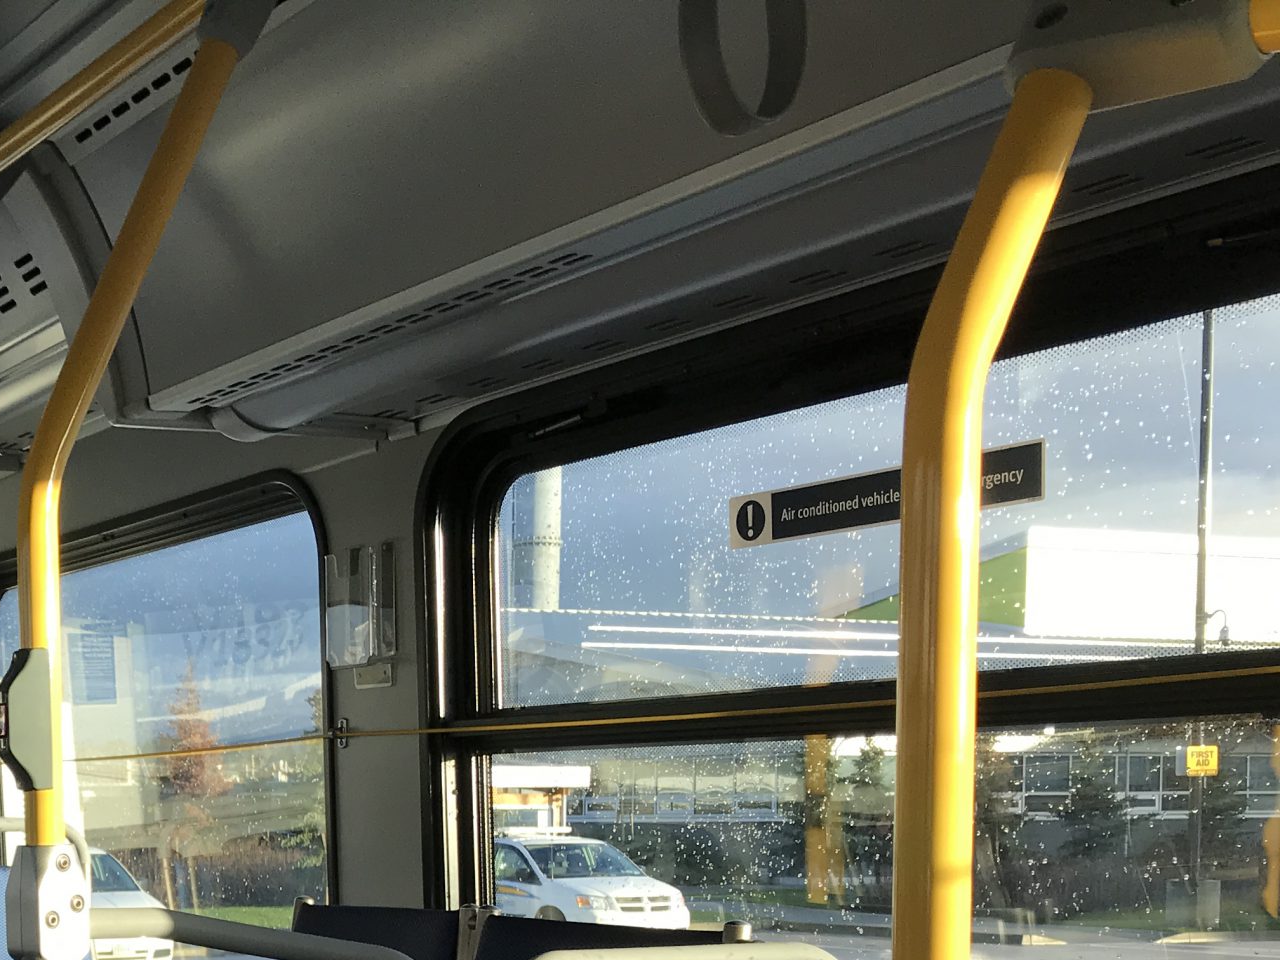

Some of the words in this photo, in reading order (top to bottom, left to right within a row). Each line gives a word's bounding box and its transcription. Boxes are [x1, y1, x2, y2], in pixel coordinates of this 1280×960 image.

[781, 507, 795, 522] Air
[798, 495, 859, 519] conditioned
[981, 469, 1024, 490] rgency
[1191, 751, 1214, 759] FIRST
[1196, 759, 1210, 767] AID
